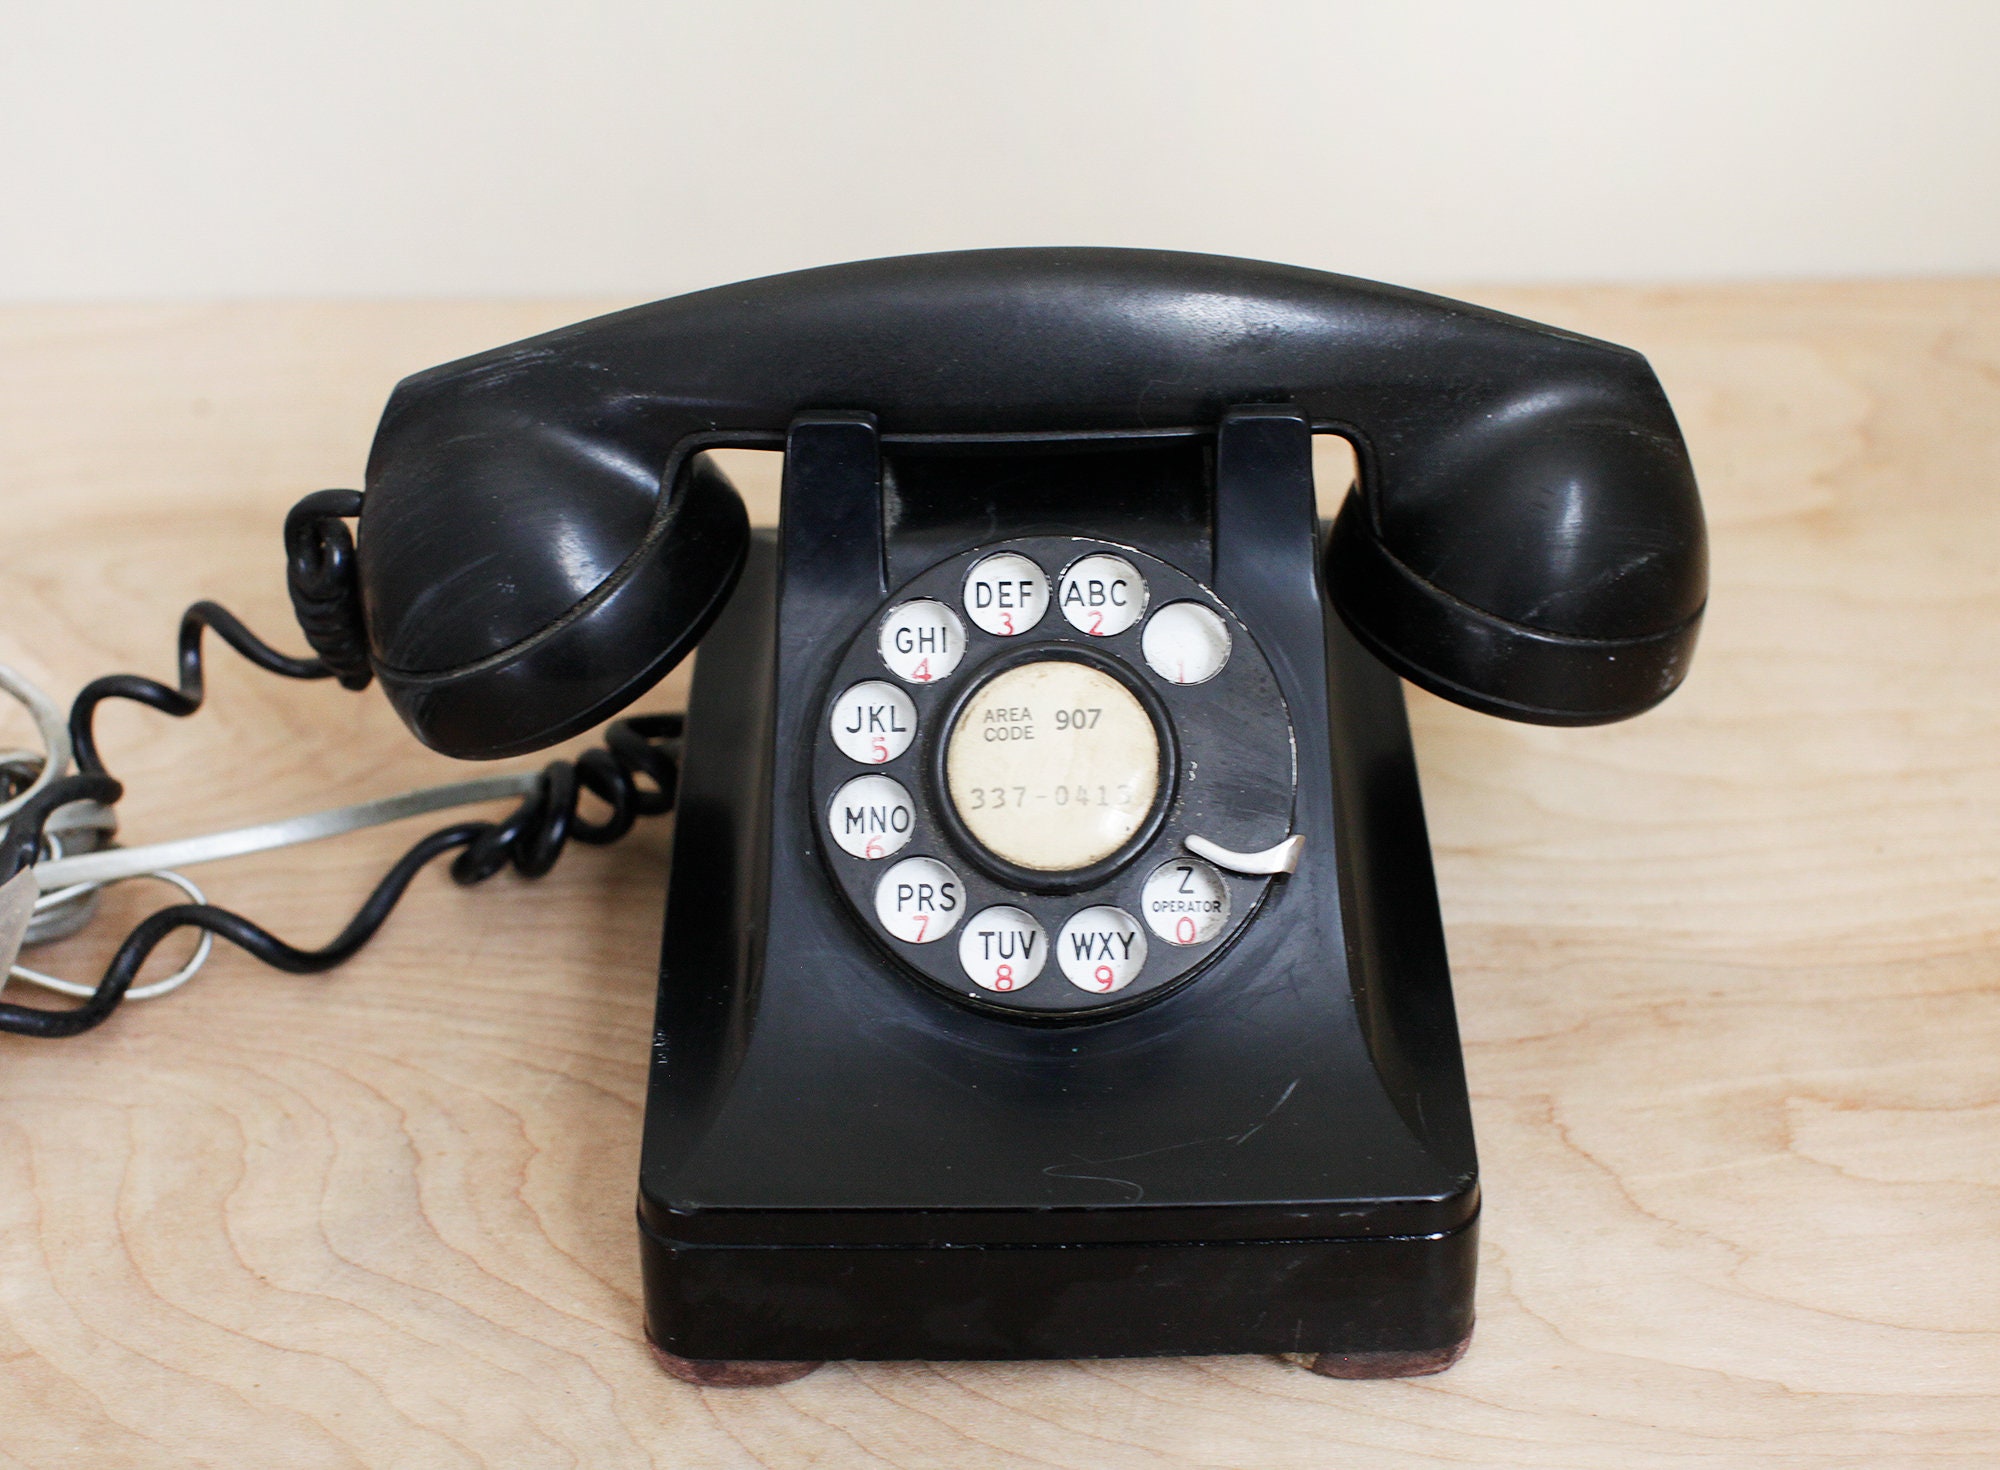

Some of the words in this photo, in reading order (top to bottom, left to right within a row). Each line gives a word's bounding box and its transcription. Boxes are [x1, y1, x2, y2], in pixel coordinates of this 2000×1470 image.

[975, 580, 1033, 609] DEF
[1064, 579, 1128, 607] ABC
[997, 612, 1015, 636] 3
[1087, 610, 1104, 636] 2
[895, 626, 947, 654] GHI
[912, 657, 932, 682] 4
[846, 705, 907, 734] JKL
[983, 707, 1033, 725] AREA
[1055, 708, 1102, 731] 907
[983, 726, 1035, 743] CODE
[871, 736, 889, 763] 5
[845, 805, 909, 835] MNO
[865, 835, 885, 859] 6
[1176, 866, 1194, 894] Z
[897, 882, 957, 913] PRS
[1152, 900, 1222, 913] OPERATOR
[912, 915, 929, 942] 7
[978, 930, 1037, 961] TUV
[1071, 931, 1135, 961] WXY
[995, 963, 1013, 991] 8
[1094, 964, 1114, 992] 9
